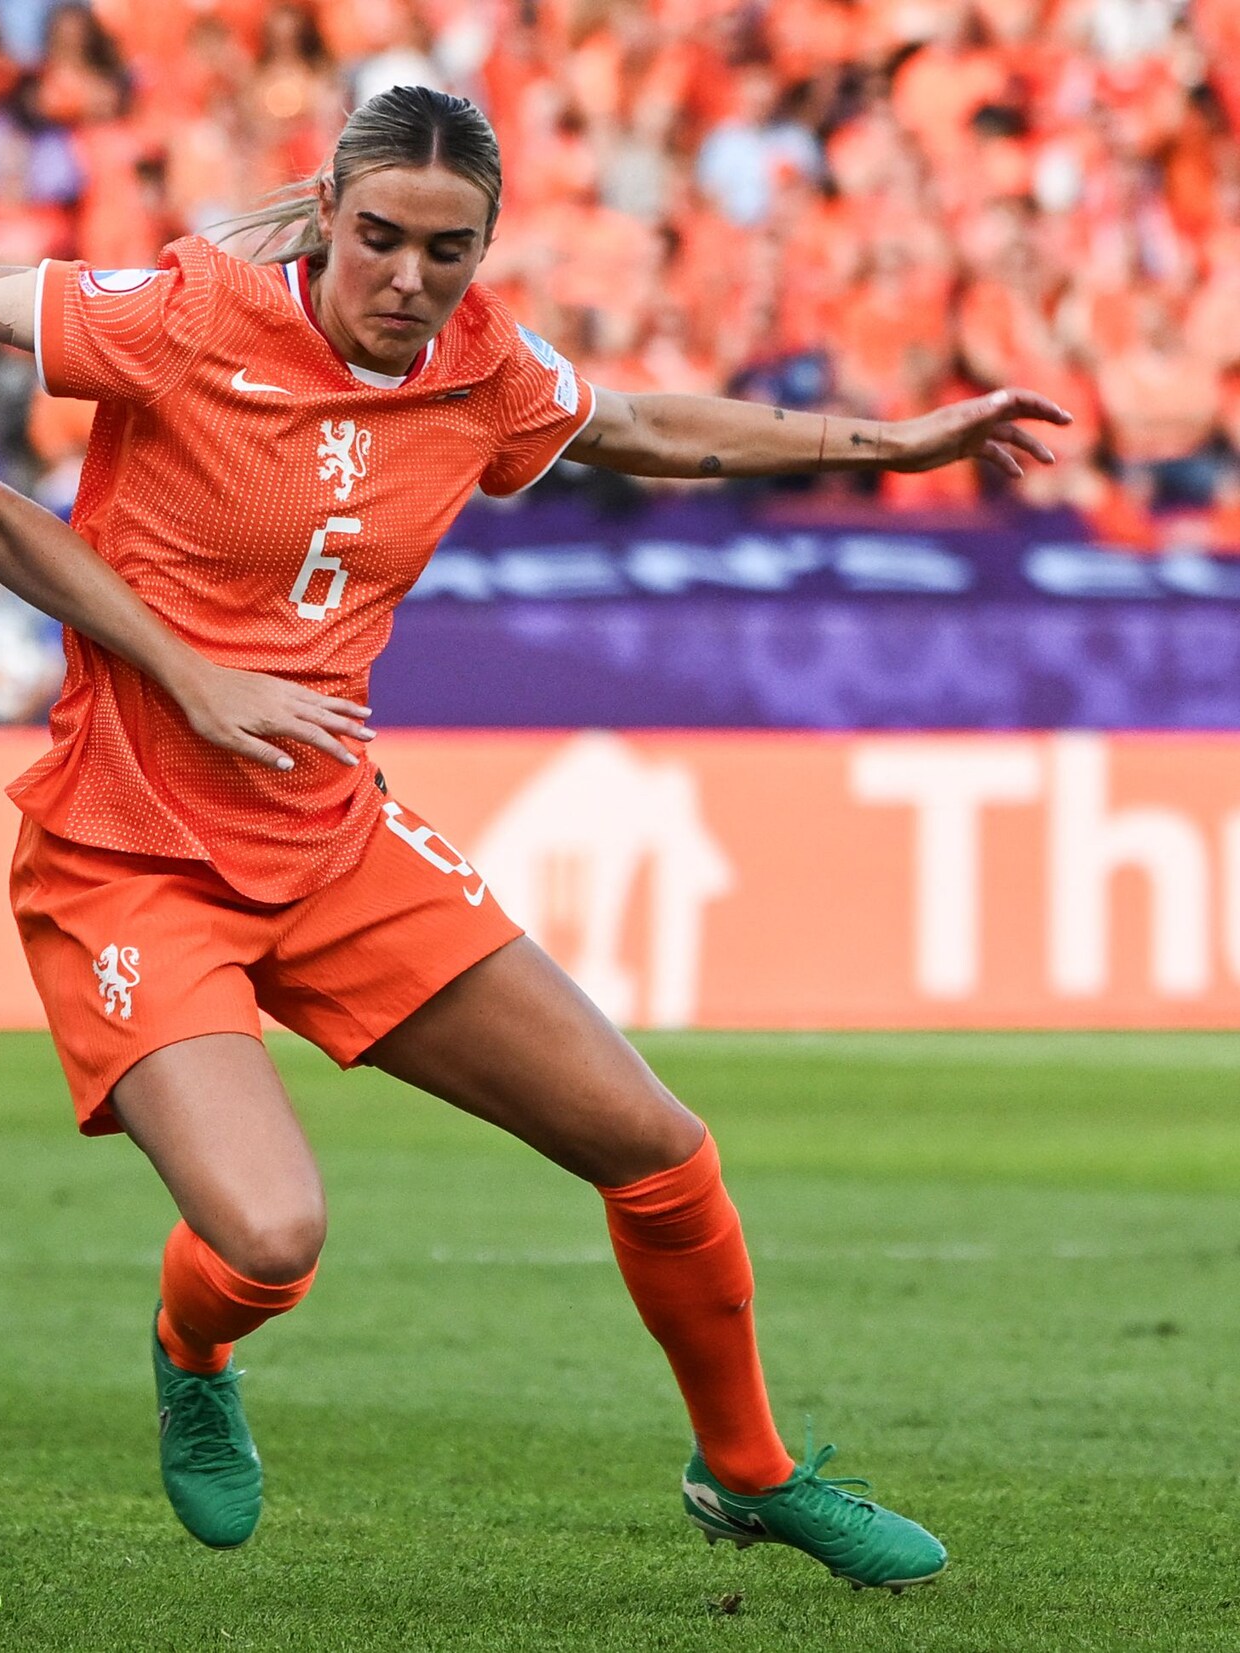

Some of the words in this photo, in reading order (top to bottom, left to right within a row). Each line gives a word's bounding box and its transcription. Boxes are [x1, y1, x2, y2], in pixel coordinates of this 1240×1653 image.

[288, 516, 361, 621] 6
[382, 800, 474, 877] 6
[848, 728, 1240, 997] Th
